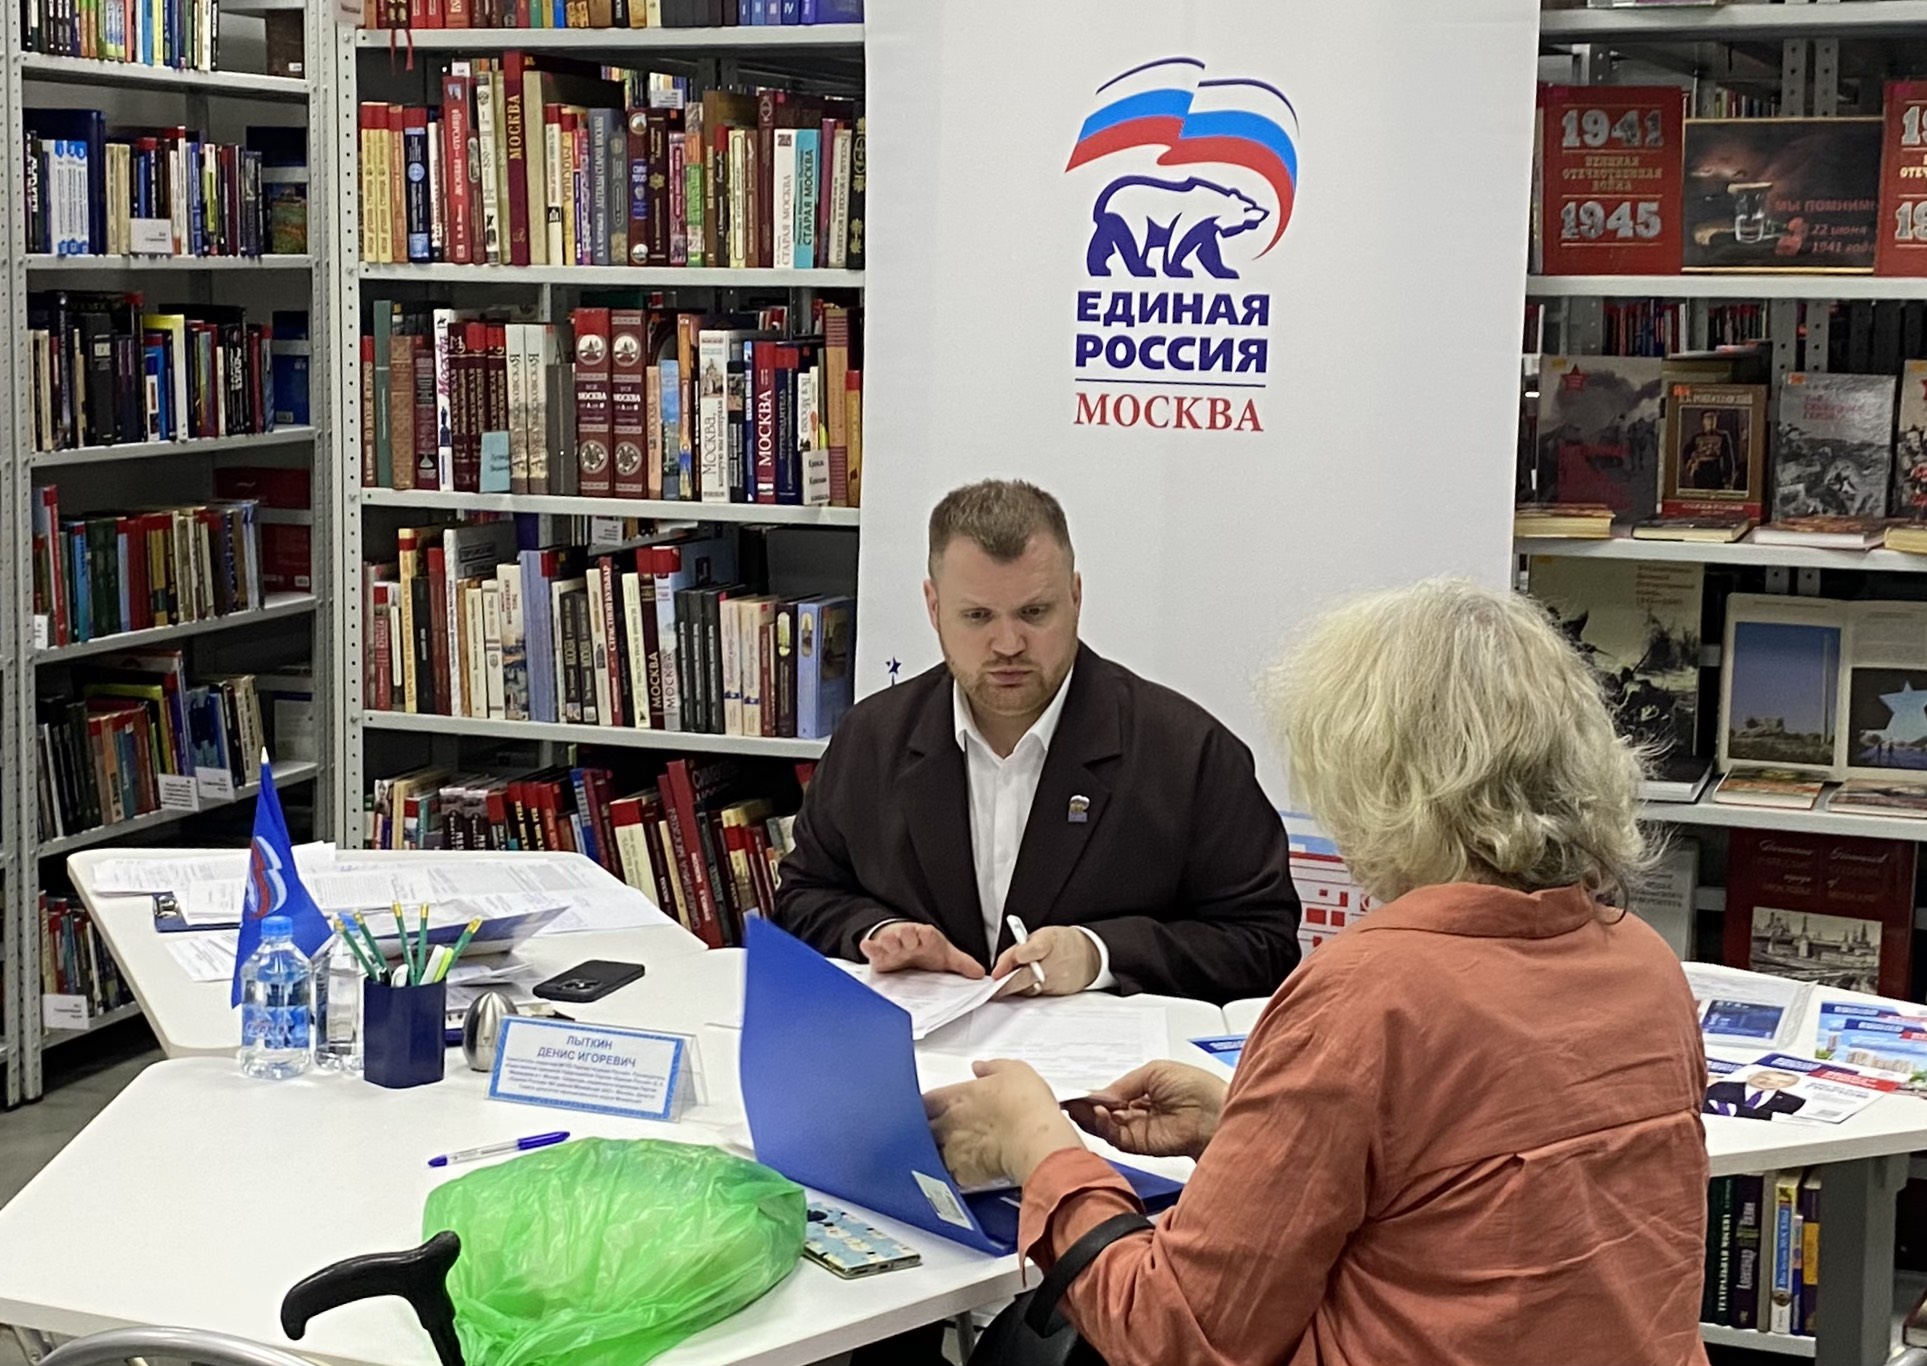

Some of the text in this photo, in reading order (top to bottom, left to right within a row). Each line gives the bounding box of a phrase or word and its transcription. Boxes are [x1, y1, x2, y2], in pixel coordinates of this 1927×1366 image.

[508, 94, 522, 160] МОСКВА
[1562, 109, 1664, 147] 1941
[562, 145, 572, 202] МОСКВА
[802, 149, 813, 246] СТАРАЯ МОСКВА
[782, 175, 791, 265] СТАРАЯ МОСКВА
[1561, 201, 1662, 239] 1945
[1811, 224, 1829, 235] 22
[1077, 290, 1271, 327] ЕДИНАЯ
[1074, 333, 1269, 374] РОССИЯ
[489, 369, 497, 430] ОСКОВСКАЯ
[578, 392, 607, 400] МОСКВА
[613, 393, 641, 402] МОСКВА
[1073, 391, 1265, 432] МОСКВА
[701, 412, 717, 475] Москва,
[758, 390, 772, 467] МОСКВА
[603, 565, 616, 651] СТРАСТНОЙ БУЛЬВАР
[649, 651, 663, 708] МОСКВА
[662, 652, 675, 709] МОСКВА
[537, 1046, 637, 1068] ДЕНИС ИГОРЕВИЧ
[566, 1035, 613, 1050] ЛЫТКИН
